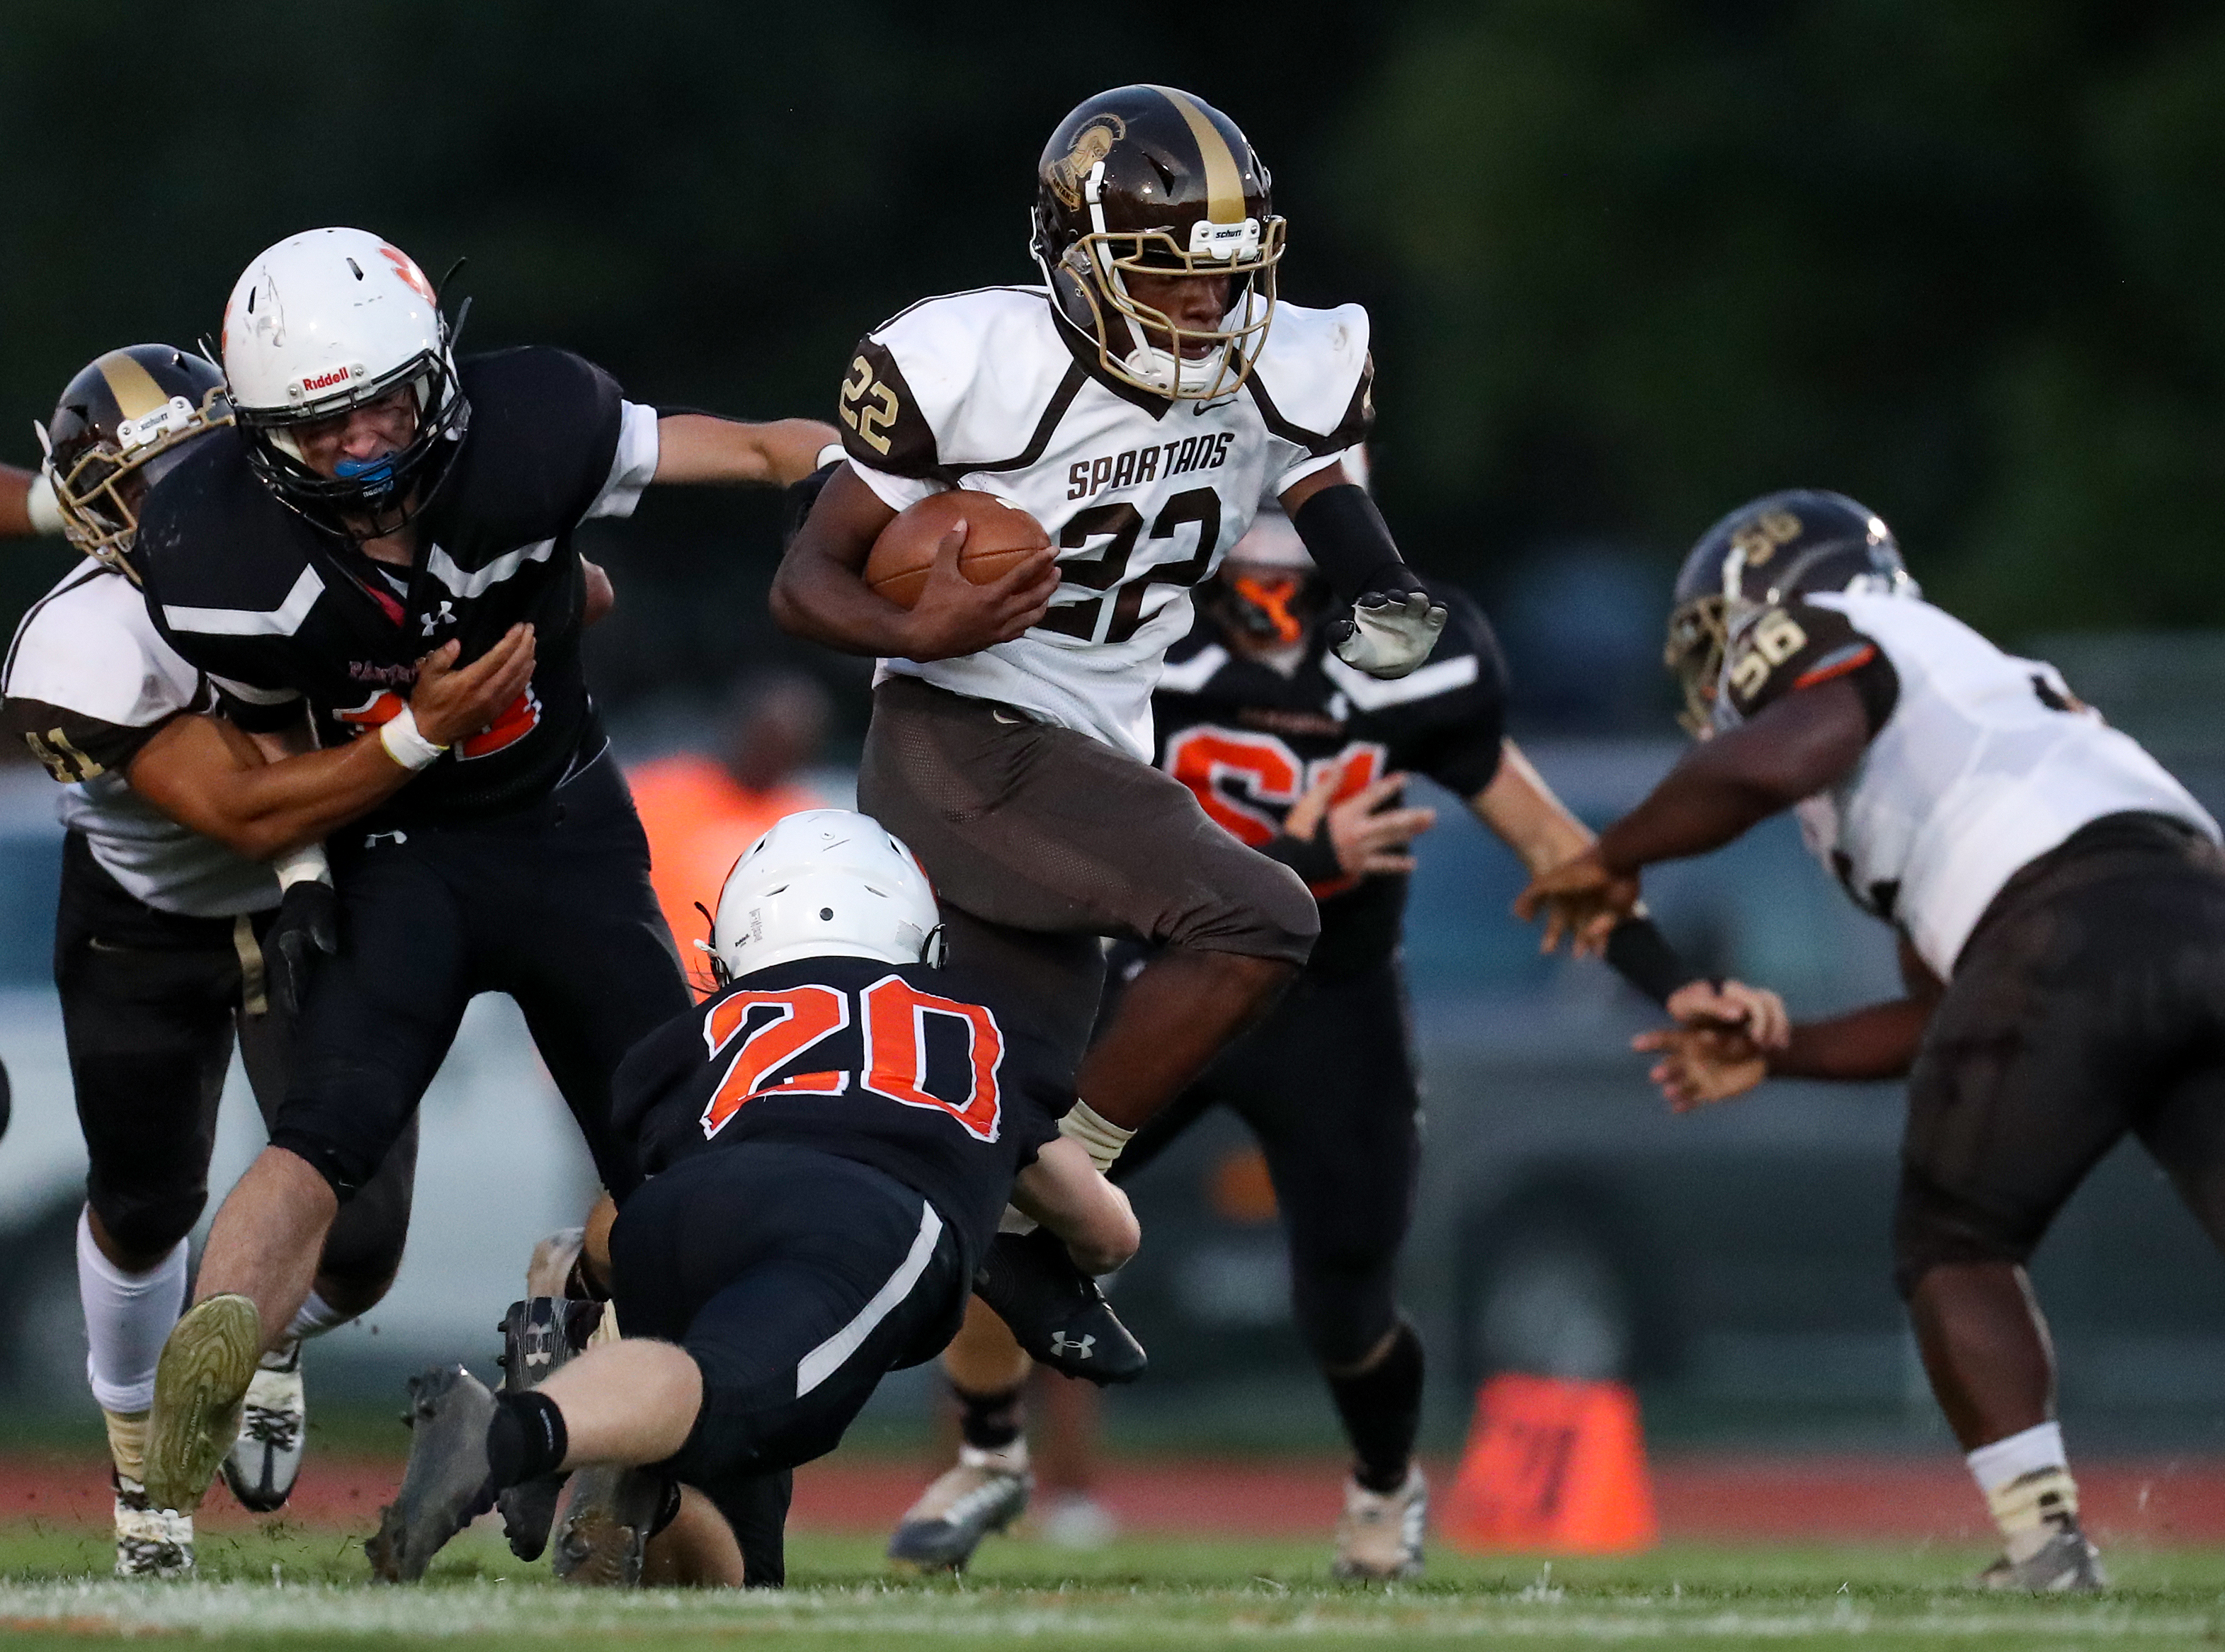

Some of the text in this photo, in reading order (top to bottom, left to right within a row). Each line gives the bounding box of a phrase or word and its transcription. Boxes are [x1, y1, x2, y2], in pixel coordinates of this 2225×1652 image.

[302, 367, 349, 391] Riddell
[839, 355, 899, 455] 22
[1067, 432, 1235, 500] SPARTANS
[1035, 486, 1222, 644] 22
[1730, 609, 1807, 700] 56
[699, 974, 1005, 1144] 20
